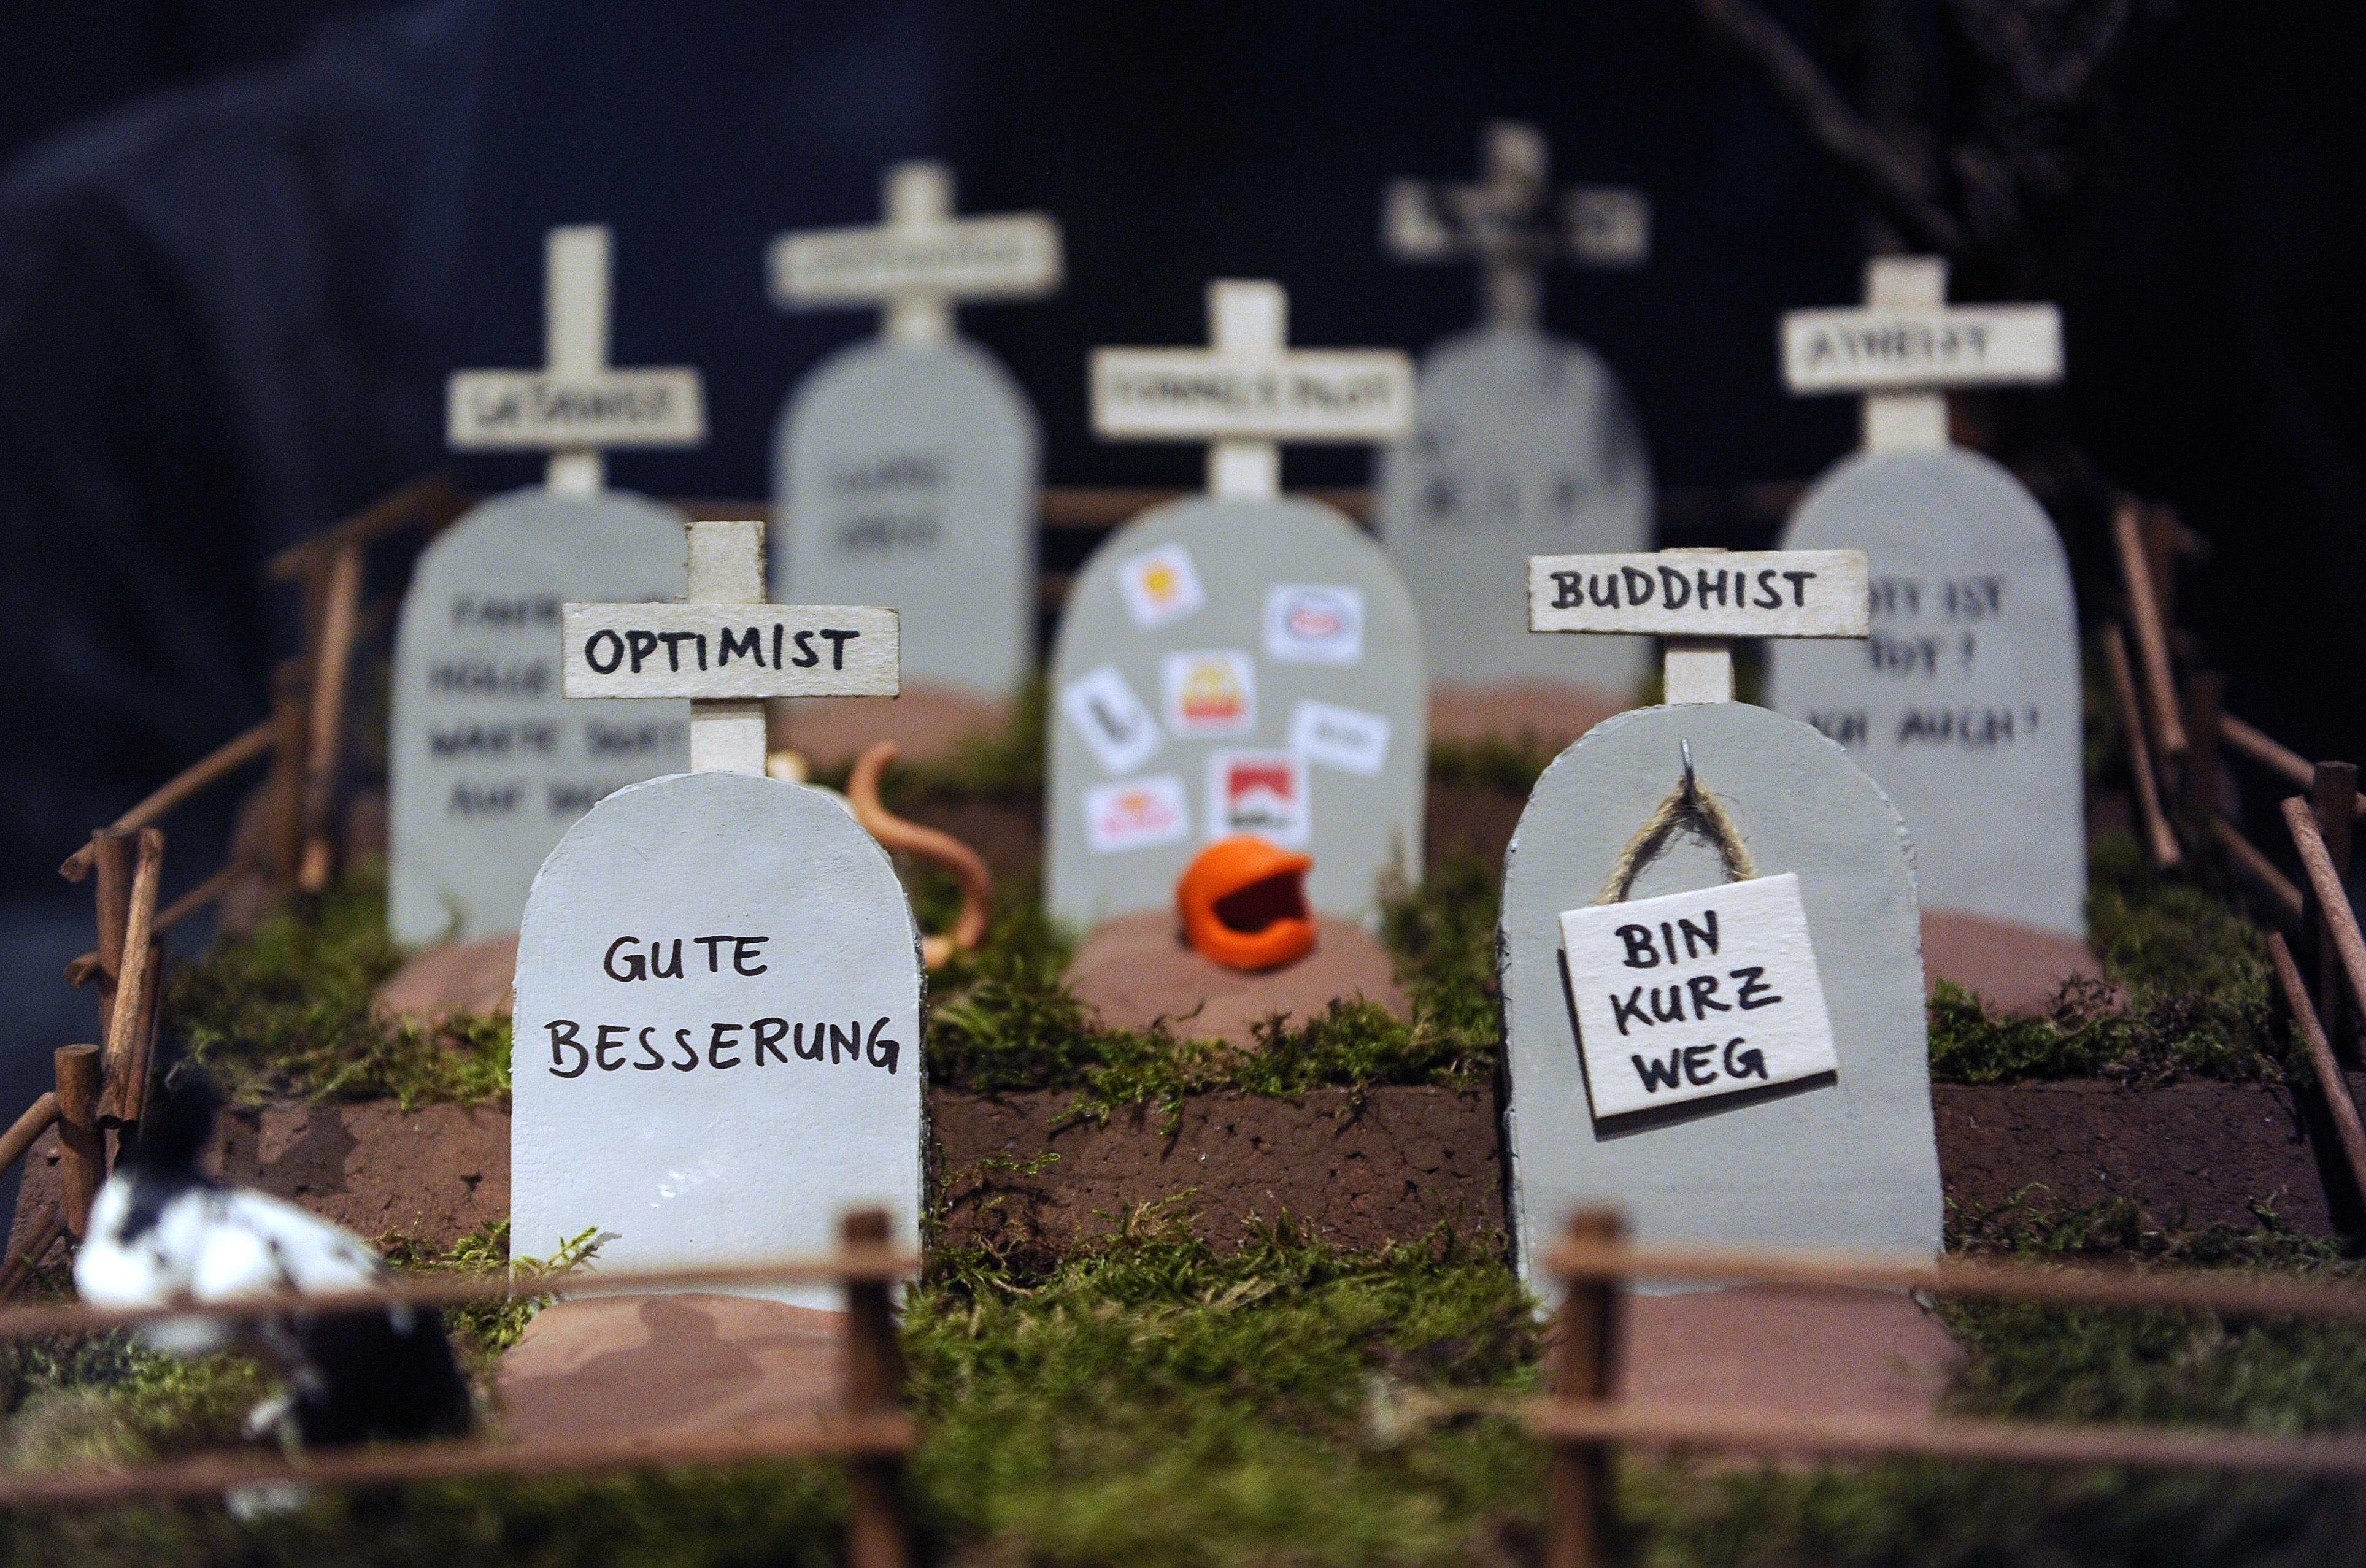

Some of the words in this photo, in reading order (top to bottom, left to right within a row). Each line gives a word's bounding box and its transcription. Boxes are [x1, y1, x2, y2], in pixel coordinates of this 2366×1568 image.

[1550, 566, 1816, 609] BUDDHIST
[1943, 576, 2004, 617] IST
[585, 623, 859, 674] OPTIMIST
[604, 936, 769, 982] GUTE
[1615, 910, 1719, 968] BIN
[1610, 967, 1782, 1036] KURZ
[544, 1017, 900, 1078] BESSERUNG
[1632, 1037, 1768, 1093] WEG
